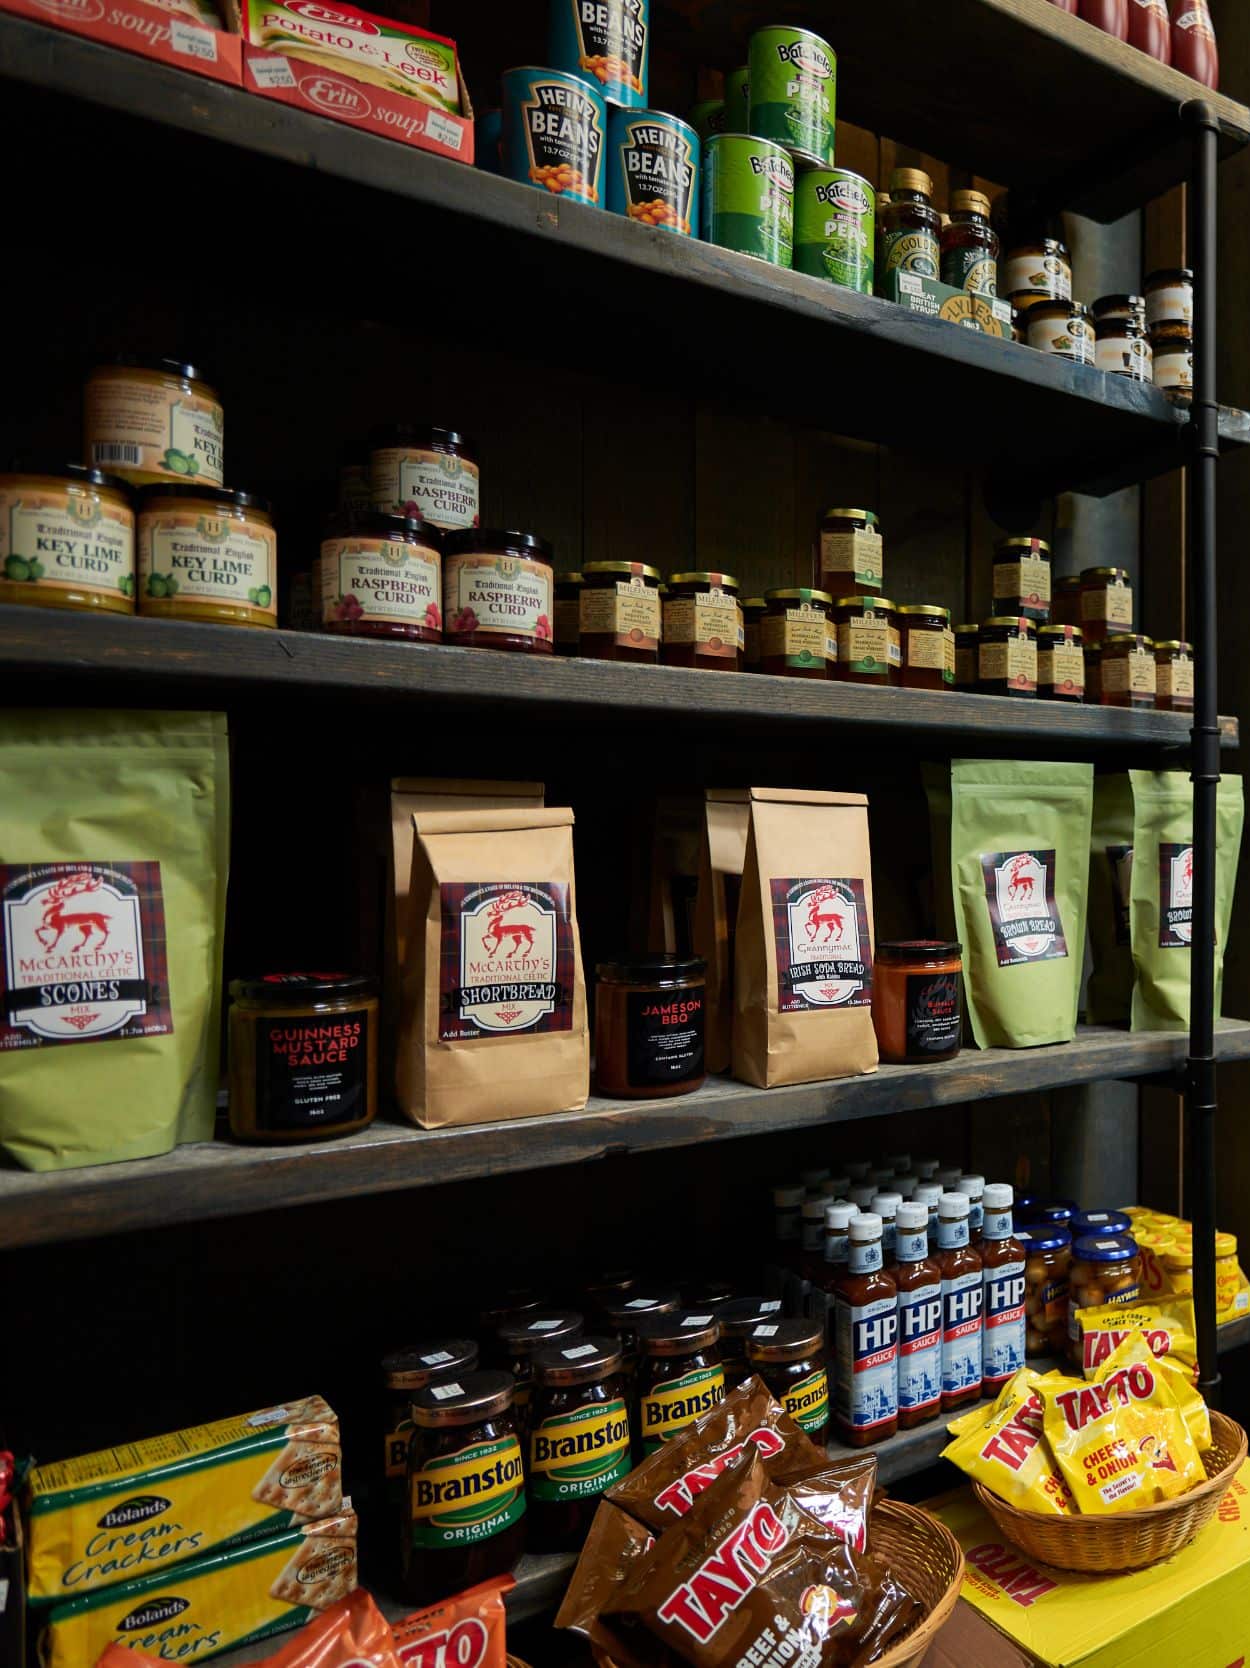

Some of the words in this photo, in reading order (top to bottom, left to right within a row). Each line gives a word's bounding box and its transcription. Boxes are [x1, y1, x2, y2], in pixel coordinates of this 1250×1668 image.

[108, 9, 173, 45] soup
[581, 2, 644, 47] BEANS
[262, 15, 354, 49] Potato
[383, 51, 448, 89] Leek
[308, 80, 358, 107] Erin
[373, 106, 426, 138] soup
[540, 88, 595, 120] HEINZ
[531, 111, 598, 153] BEANS
[635, 128, 685, 157] HEINZ
[628, 151, 690, 187] BEANS
[825, 221, 868, 249] PEAS
[947, 299, 993, 325] LYLE'S
[194, 437, 216, 457] KEY
[412, 485, 477, 508] RASPBERRY
[433, 499, 467, 515] CURD
[37, 537, 77, 554] KEY
[83, 542, 123, 563] LIME
[171, 542, 221, 556] Traditional
[56, 554, 110, 573] CURD
[171, 555, 207, 570] KEY
[212, 559, 253, 576] LIME
[188, 570, 238, 586] CURD
[351, 577, 432, 597] RASPBERRY
[374, 590, 416, 605] CURD
[469, 591, 543, 610] RASPBERRY
[489, 603, 527, 617] CURD
[1001, 920, 1029, 938] BROWN
[1029, 919, 1056, 933] BREAD
[21, 970, 94, 985] TRADITIONAL
[98, 968, 133, 978] CELTIC
[471, 974, 521, 984] TRADITIONAL
[790, 963, 812, 979] IRISH
[813, 962, 837, 975] SODA
[837, 962, 865, 975] BREAD
[40, 980, 121, 1006] SCONES
[461, 984, 556, 1006] SHORTBREAD
[641, 1000, 701, 1016] JAMESON
[662, 1013, 689, 1025] BBQ
[270, 1023, 361, 1042] GUINNESS
[273, 1037, 358, 1055] MUSTARD
[288, 1051, 348, 1066] SAUCE
[950, 1287, 983, 1322] HP
[991, 1276, 1025, 1309] HP
[905, 1300, 941, 1336] HP
[997, 1309, 1022, 1324] SAUCE
[858, 1314, 897, 1351] HP
[955, 1321, 979, 1337] SAUCE
[912, 1336, 938, 1352] SAUCE
[866, 1350, 893, 1367] SAUCE
[1055, 1361, 1156, 1433] TAYTO
[570, 1412, 591, 1422] SINCE
[534, 1416, 630, 1462] Branston
[454, 1451, 477, 1463] SINCE
[1086, 1472, 1097, 1486] &
[1097, 1451, 1138, 1480] ONION
[416, 1455, 523, 1508] Branston
[559, 1469, 619, 1494] ORIGINAL
[105, 1498, 168, 1527] Bolands
[443, 1511, 511, 1541] ORIGINAL
[86, 1522, 184, 1557] Cream
[61, 1531, 203, 1587] Crackers
[656, 1500, 789, 1645] TAYTO
[125, 1601, 186, 1630] Bolands
[774, 1614, 790, 1632] &
[160, 1630, 222, 1660] kers
